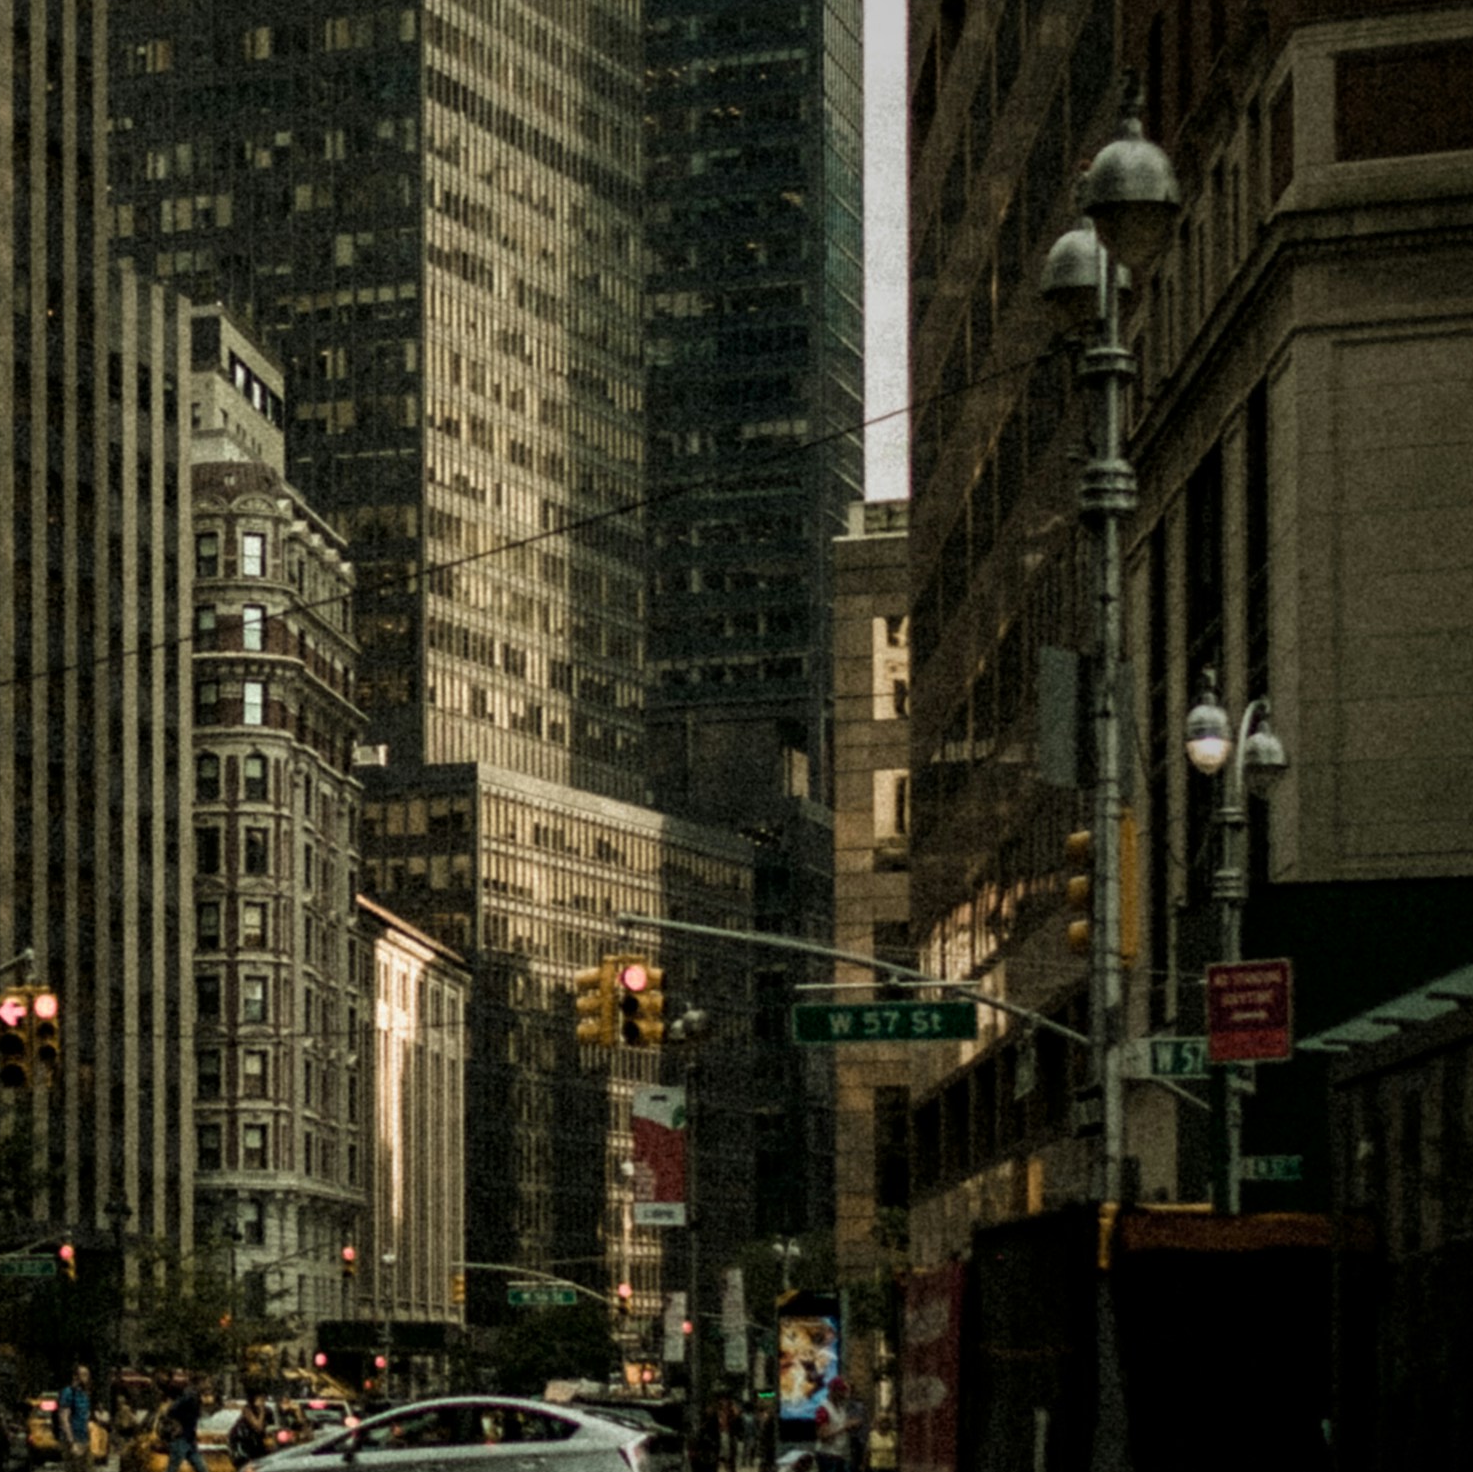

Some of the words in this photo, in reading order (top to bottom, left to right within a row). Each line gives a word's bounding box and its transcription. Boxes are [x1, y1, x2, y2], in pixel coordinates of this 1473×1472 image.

[828, 1012, 854, 1035] W
[862, 1010, 901, 1035] 57
[911, 1008, 942, 1033] St
[1154, 1041, 1175, 1074] W
